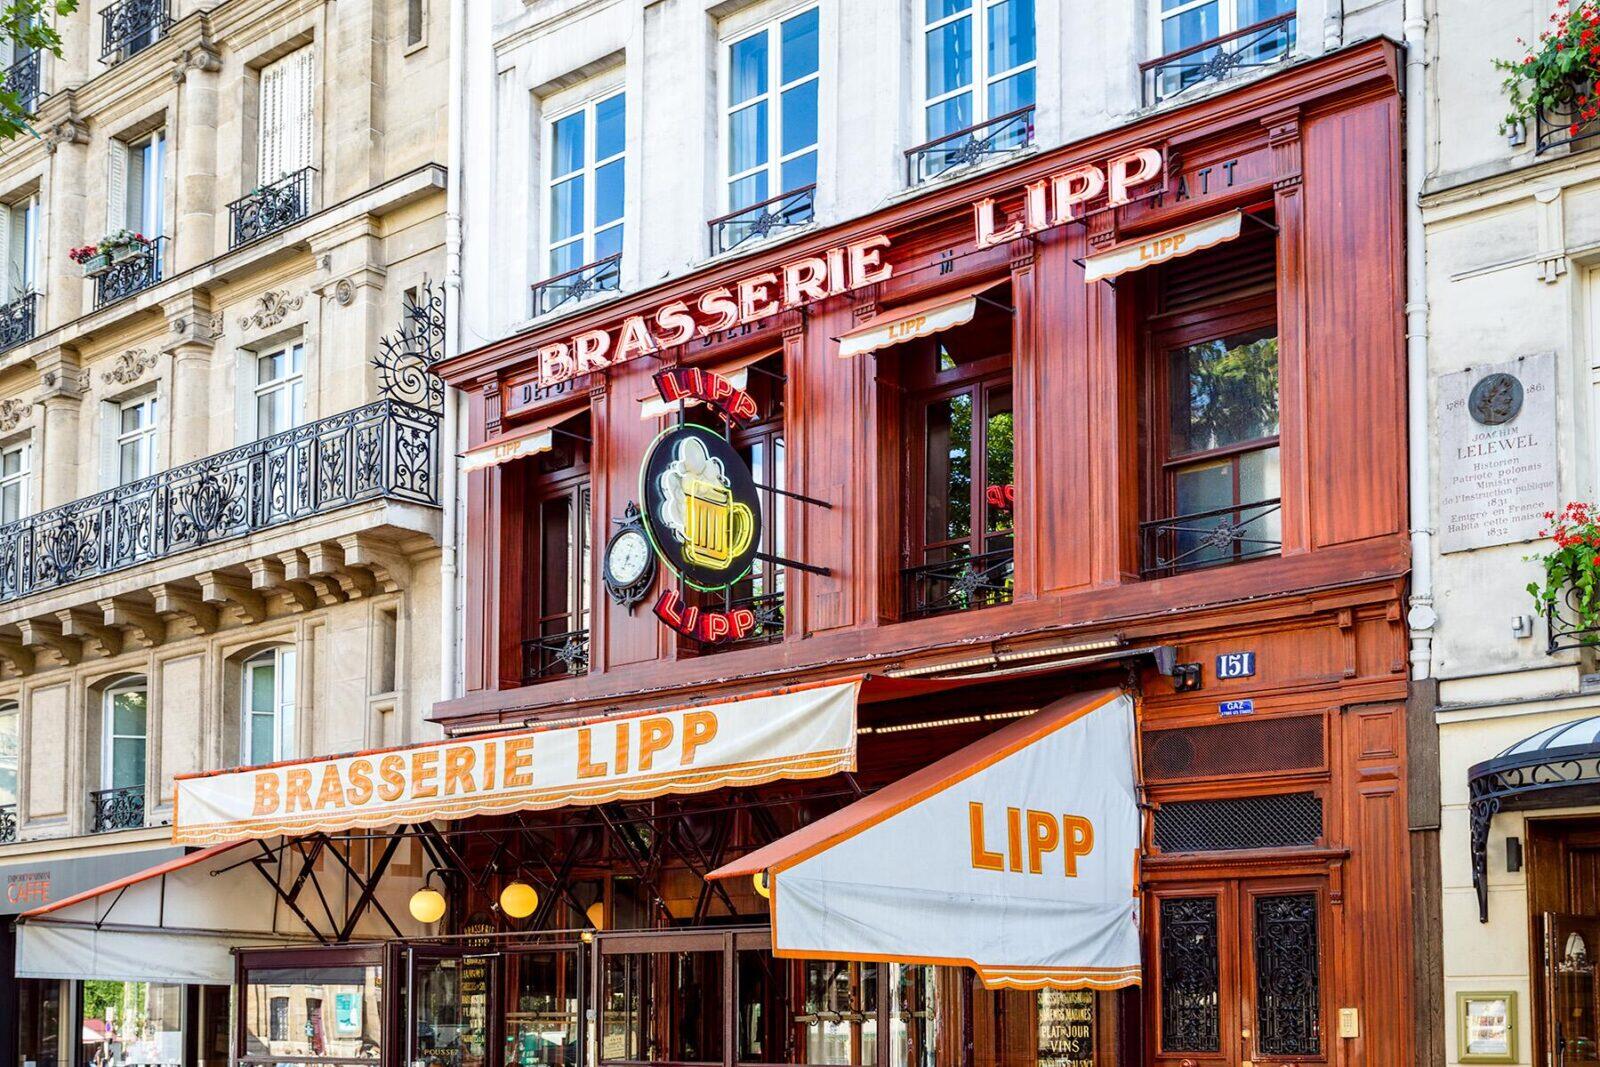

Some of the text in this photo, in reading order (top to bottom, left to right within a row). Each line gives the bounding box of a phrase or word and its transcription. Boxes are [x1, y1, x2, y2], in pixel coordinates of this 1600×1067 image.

[1139, 233, 1186, 261] LIPP
[537, 148, 1163, 388] BRASSERIE LIPP
[888, 316, 927, 339] LIPP
[663, 366, 758, 418] LIPP
[1472, 426, 1519, 442] JOACHIM
[495, 440, 521, 458] LIPP
[1457, 433, 1538, 460] LELEWEL
[1473, 457, 1520, 471] Historien
[1452, 462, 1542, 485] Patriote polonais
[1476, 477, 1518, 489] Ministre
[1515, 480, 1554, 495] publique
[1508, 501, 1545, 514] France
[1447, 521, 1479, 533] Habita
[664, 589, 755, 641] LIPP
[1220, 653, 1250, 677] 151
[1227, 701, 1244, 710] GAZ
[252, 710, 719, 817] BRASSERIE LIPP
[969, 801, 1095, 878] LIPP
[468, 938, 490, 947] LIPP
[1041, 1025, 1060, 1038] PLAT
[1066, 1025, 1090, 1038] JOUR
[1050, 1040, 1080, 1053] VINS
